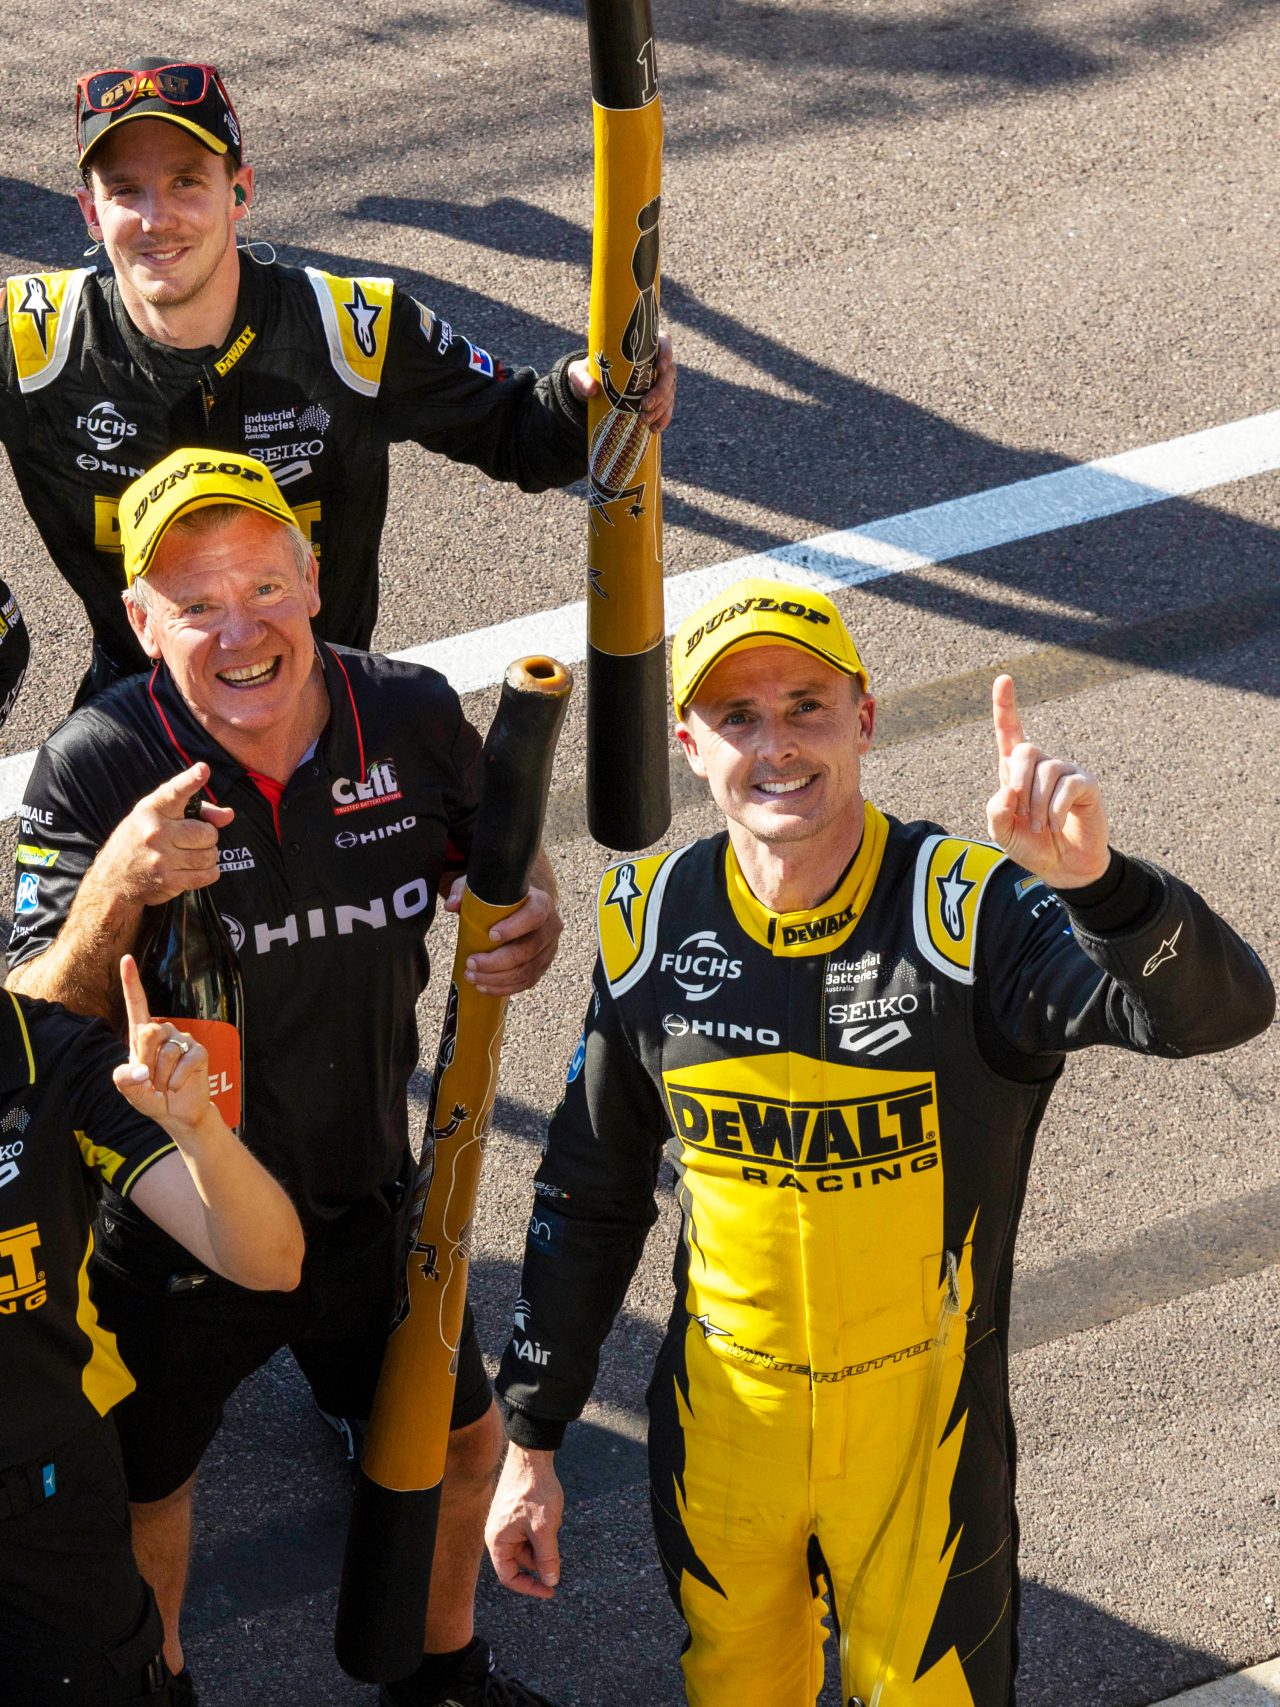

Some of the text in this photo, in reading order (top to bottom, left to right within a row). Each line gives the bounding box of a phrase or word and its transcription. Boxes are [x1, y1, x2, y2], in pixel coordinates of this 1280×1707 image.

[77, 415, 137, 436] FUCHS
[244, 409, 295, 423] Industrial
[244, 420, 295, 433] Batteries
[248, 440, 324, 462] SEIKO
[102, 460, 145, 477] HIN
[134, 461, 263, 529] DUNLOP
[685, 597, 830, 657] DUNLOP
[336, 793, 401, 813] TRUSTED BATTERY SYSTEMS
[360, 816, 416, 844] HINO
[255, 878, 428, 955] HINO
[660, 953, 743, 979] FUCHS
[829, 994, 918, 1024] SEIKO
[692, 1020, 780, 1046] HINO
[742, 1152, 939, 1194] RACING
[726, 1339, 940, 1383] WINTERBOTTO
